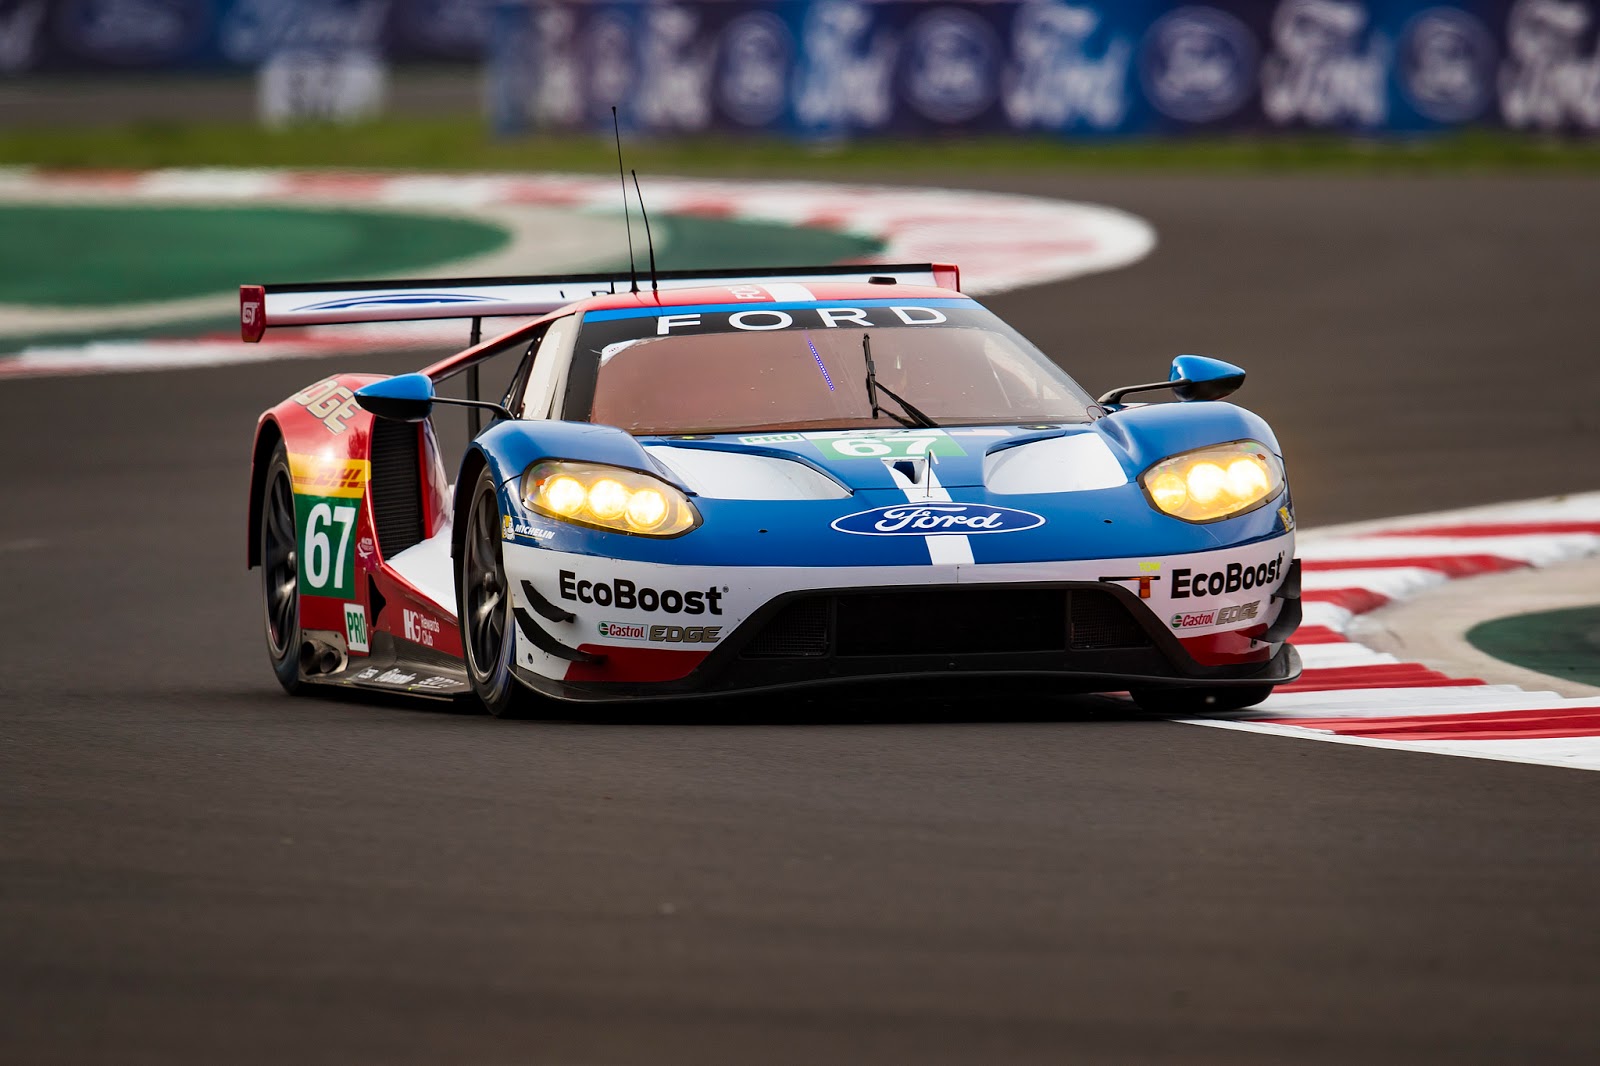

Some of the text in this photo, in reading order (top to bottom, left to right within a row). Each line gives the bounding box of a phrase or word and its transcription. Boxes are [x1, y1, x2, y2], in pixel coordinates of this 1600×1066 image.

[656, 306, 948, 335] FORD
[293, 377, 363, 436] DGE
[831, 437, 938, 457] 67
[314, 468, 362, 489] DHL
[514, 523, 556, 540] MICHELIN
[874, 505, 1004, 532] Ford
[304, 502, 357, 589] 67
[1170, 552, 1283, 600] EcoBoost
[559, 568, 723, 616] EcoBoost
[346, 610, 368, 646] PRO
[403, 608, 421, 643] IHG
[1182, 600, 1261, 628] Castrol EDGE
[609, 623, 724, 643] Castrol EDGE
